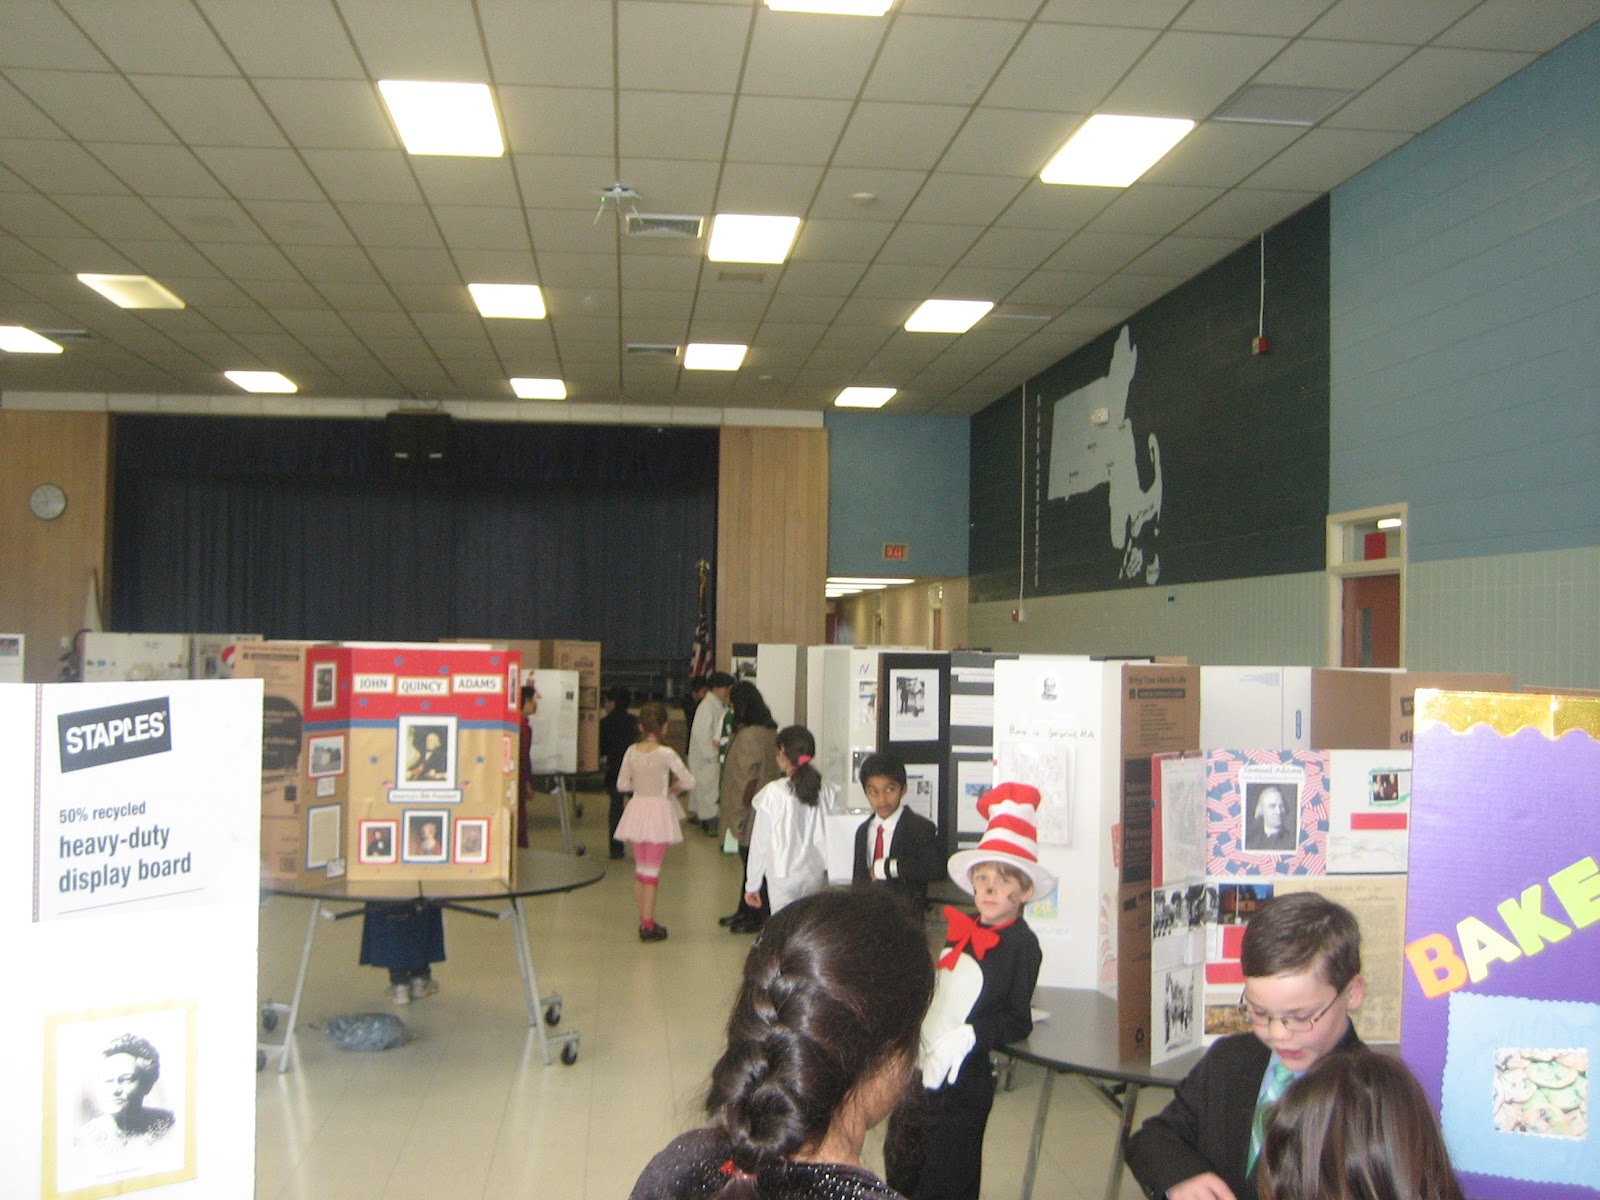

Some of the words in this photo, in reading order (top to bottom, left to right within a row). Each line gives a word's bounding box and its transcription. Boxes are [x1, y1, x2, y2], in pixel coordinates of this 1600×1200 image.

[885, 544, 906, 559] EXIT
[359, 678, 388, 688] JOHN
[401, 681, 443, 693] QUINCY
[458, 678, 497, 689] ADAMS
[59, 806, 88, 823] 50%
[92, 801, 146, 820] recycled
[59, 824, 170, 858] heavy-duty
[59, 863, 131, 893] display
[138, 851, 191, 880] board
[1405, 855, 1600, 999] BAKE
